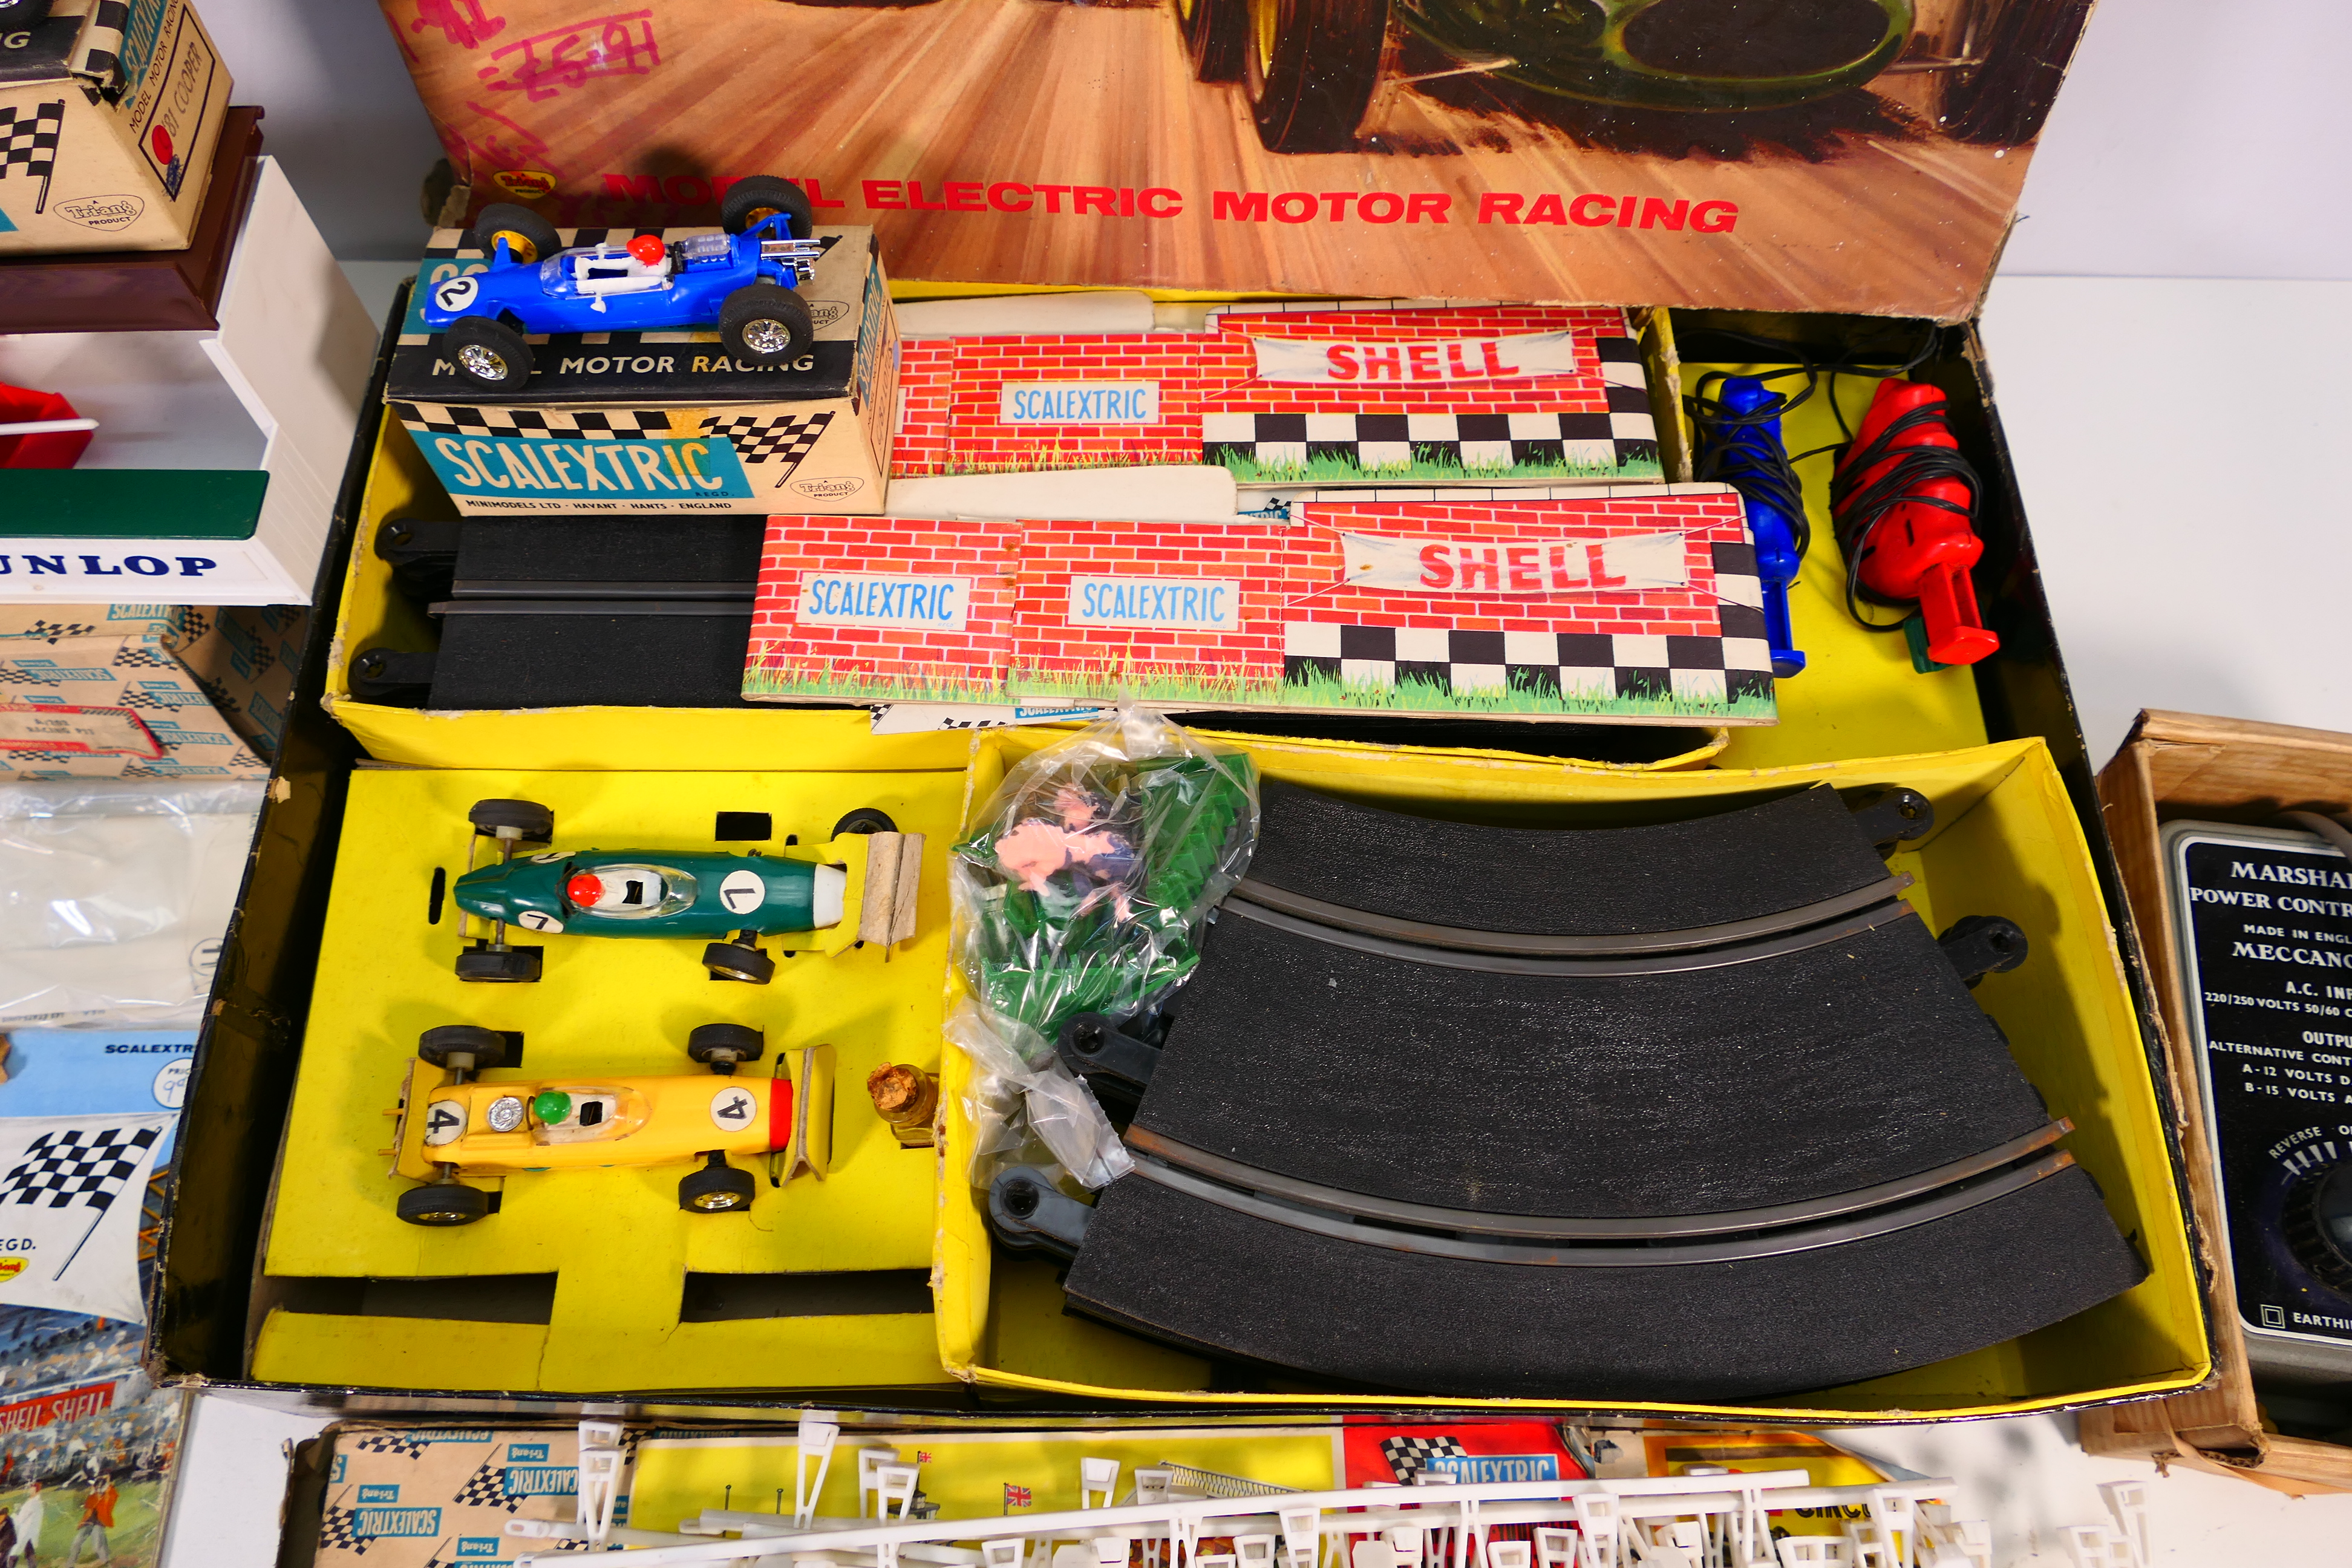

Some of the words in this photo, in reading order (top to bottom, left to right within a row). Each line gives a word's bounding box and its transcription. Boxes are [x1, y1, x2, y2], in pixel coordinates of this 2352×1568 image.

[0, 31, 31, 49] G
[129, 91, 152, 134] MODEL
[149, 41, 168, 86] MOTOR
[161, 107, 179, 137] 81
[174, 42, 203, 114] COOPER
[602, 173, 845, 207] MOL
[863, 179, 1184, 218] ELECTRIC
[1213, 191, 1452, 224] MOTOR
[1478, 192, 1739, 234] RACING
[88, 217, 131, 226] PRODUCT
[440, 281, 471, 307] 2
[559, 356, 675, 374] MOTOR
[1326, 342, 1519, 380] SHELL
[1013, 388, 1146, 419] SCALEXTRIC
[434, 437, 724, 492] SCALEXTRIC
[465, 500, 536, 509] MINIMODELS
[1420, 543, 1626, 590] SHELL
[808, 580, 955, 622] SCALEXTRIC
[1082, 583, 1226, 623] SCALEXTRIC
[724, 887, 756, 910] 7
[2190, 887, 2273, 909] POWER
[528, 913, 549, 930] 7
[2243, 924, 2285, 938] MADE
[2292, 929, 2309, 939] IN
[2315, 932, 2352, 944] ENGL
[2285, 981, 2318, 996] A.C.
[2204, 991, 2255, 1007] 220/250
[2256, 998, 2299, 1011] VOLTS
[2304, 1004, 2340, 1017] 50/60
[2209, 1040, 2304, 1061] ALTERNATIVE
[2311, 1053, 2352, 1067] CONT
[2284, 1068, 2333, 1083] VOLTS
[2287, 1087, 2336, 1102] VOLTS
[718, 1096, 751, 1120] 4
[427, 1109, 460, 1137] 4
[2338, 1125, 2352, 1136] O
[2267, 1126, 2322, 1159] REVERSE
[52, 1391, 105, 1423] SHELL
[510, 1469, 579, 1494] CALEXTRIC
[359, 1510, 437, 1535] SCALEXTRIC
